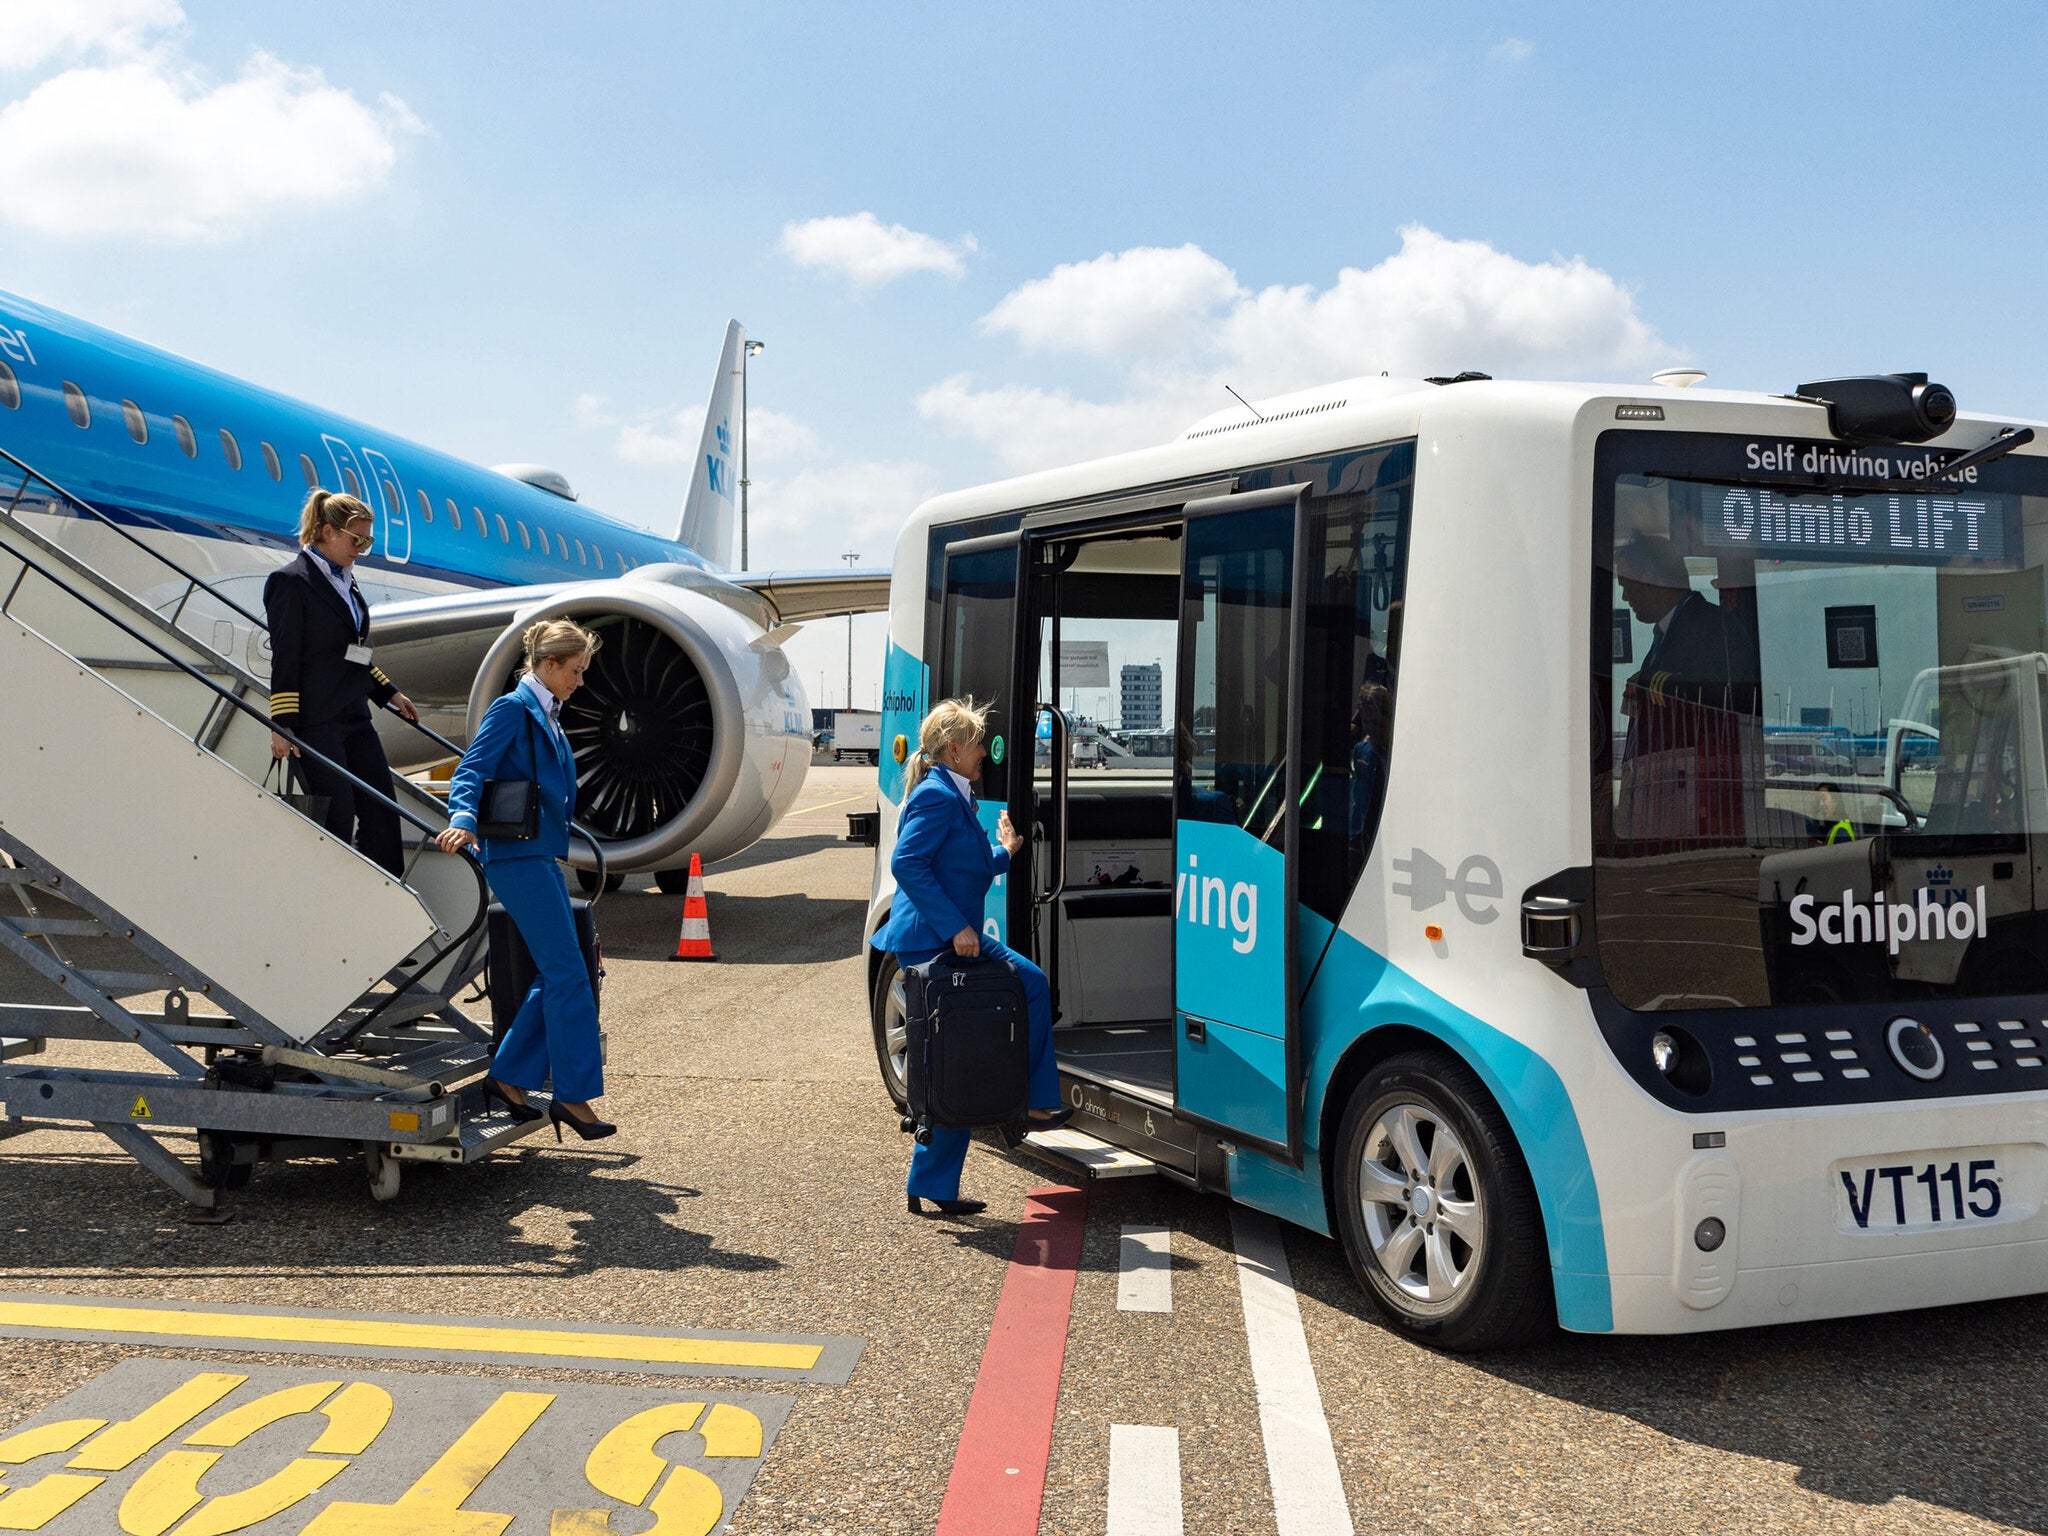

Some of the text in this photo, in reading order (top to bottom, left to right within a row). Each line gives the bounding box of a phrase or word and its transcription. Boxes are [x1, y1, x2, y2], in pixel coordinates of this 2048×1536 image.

[1745, 443, 1795, 472] Self
[1802, 446, 1890, 480] driving
[1723, 488, 1986, 550] Ohmio LIFT
[882, 689, 916, 717] Schiphol
[1789, 885, 1987, 955] Schiphol
[1840, 1160, 2002, 1229] VT115
